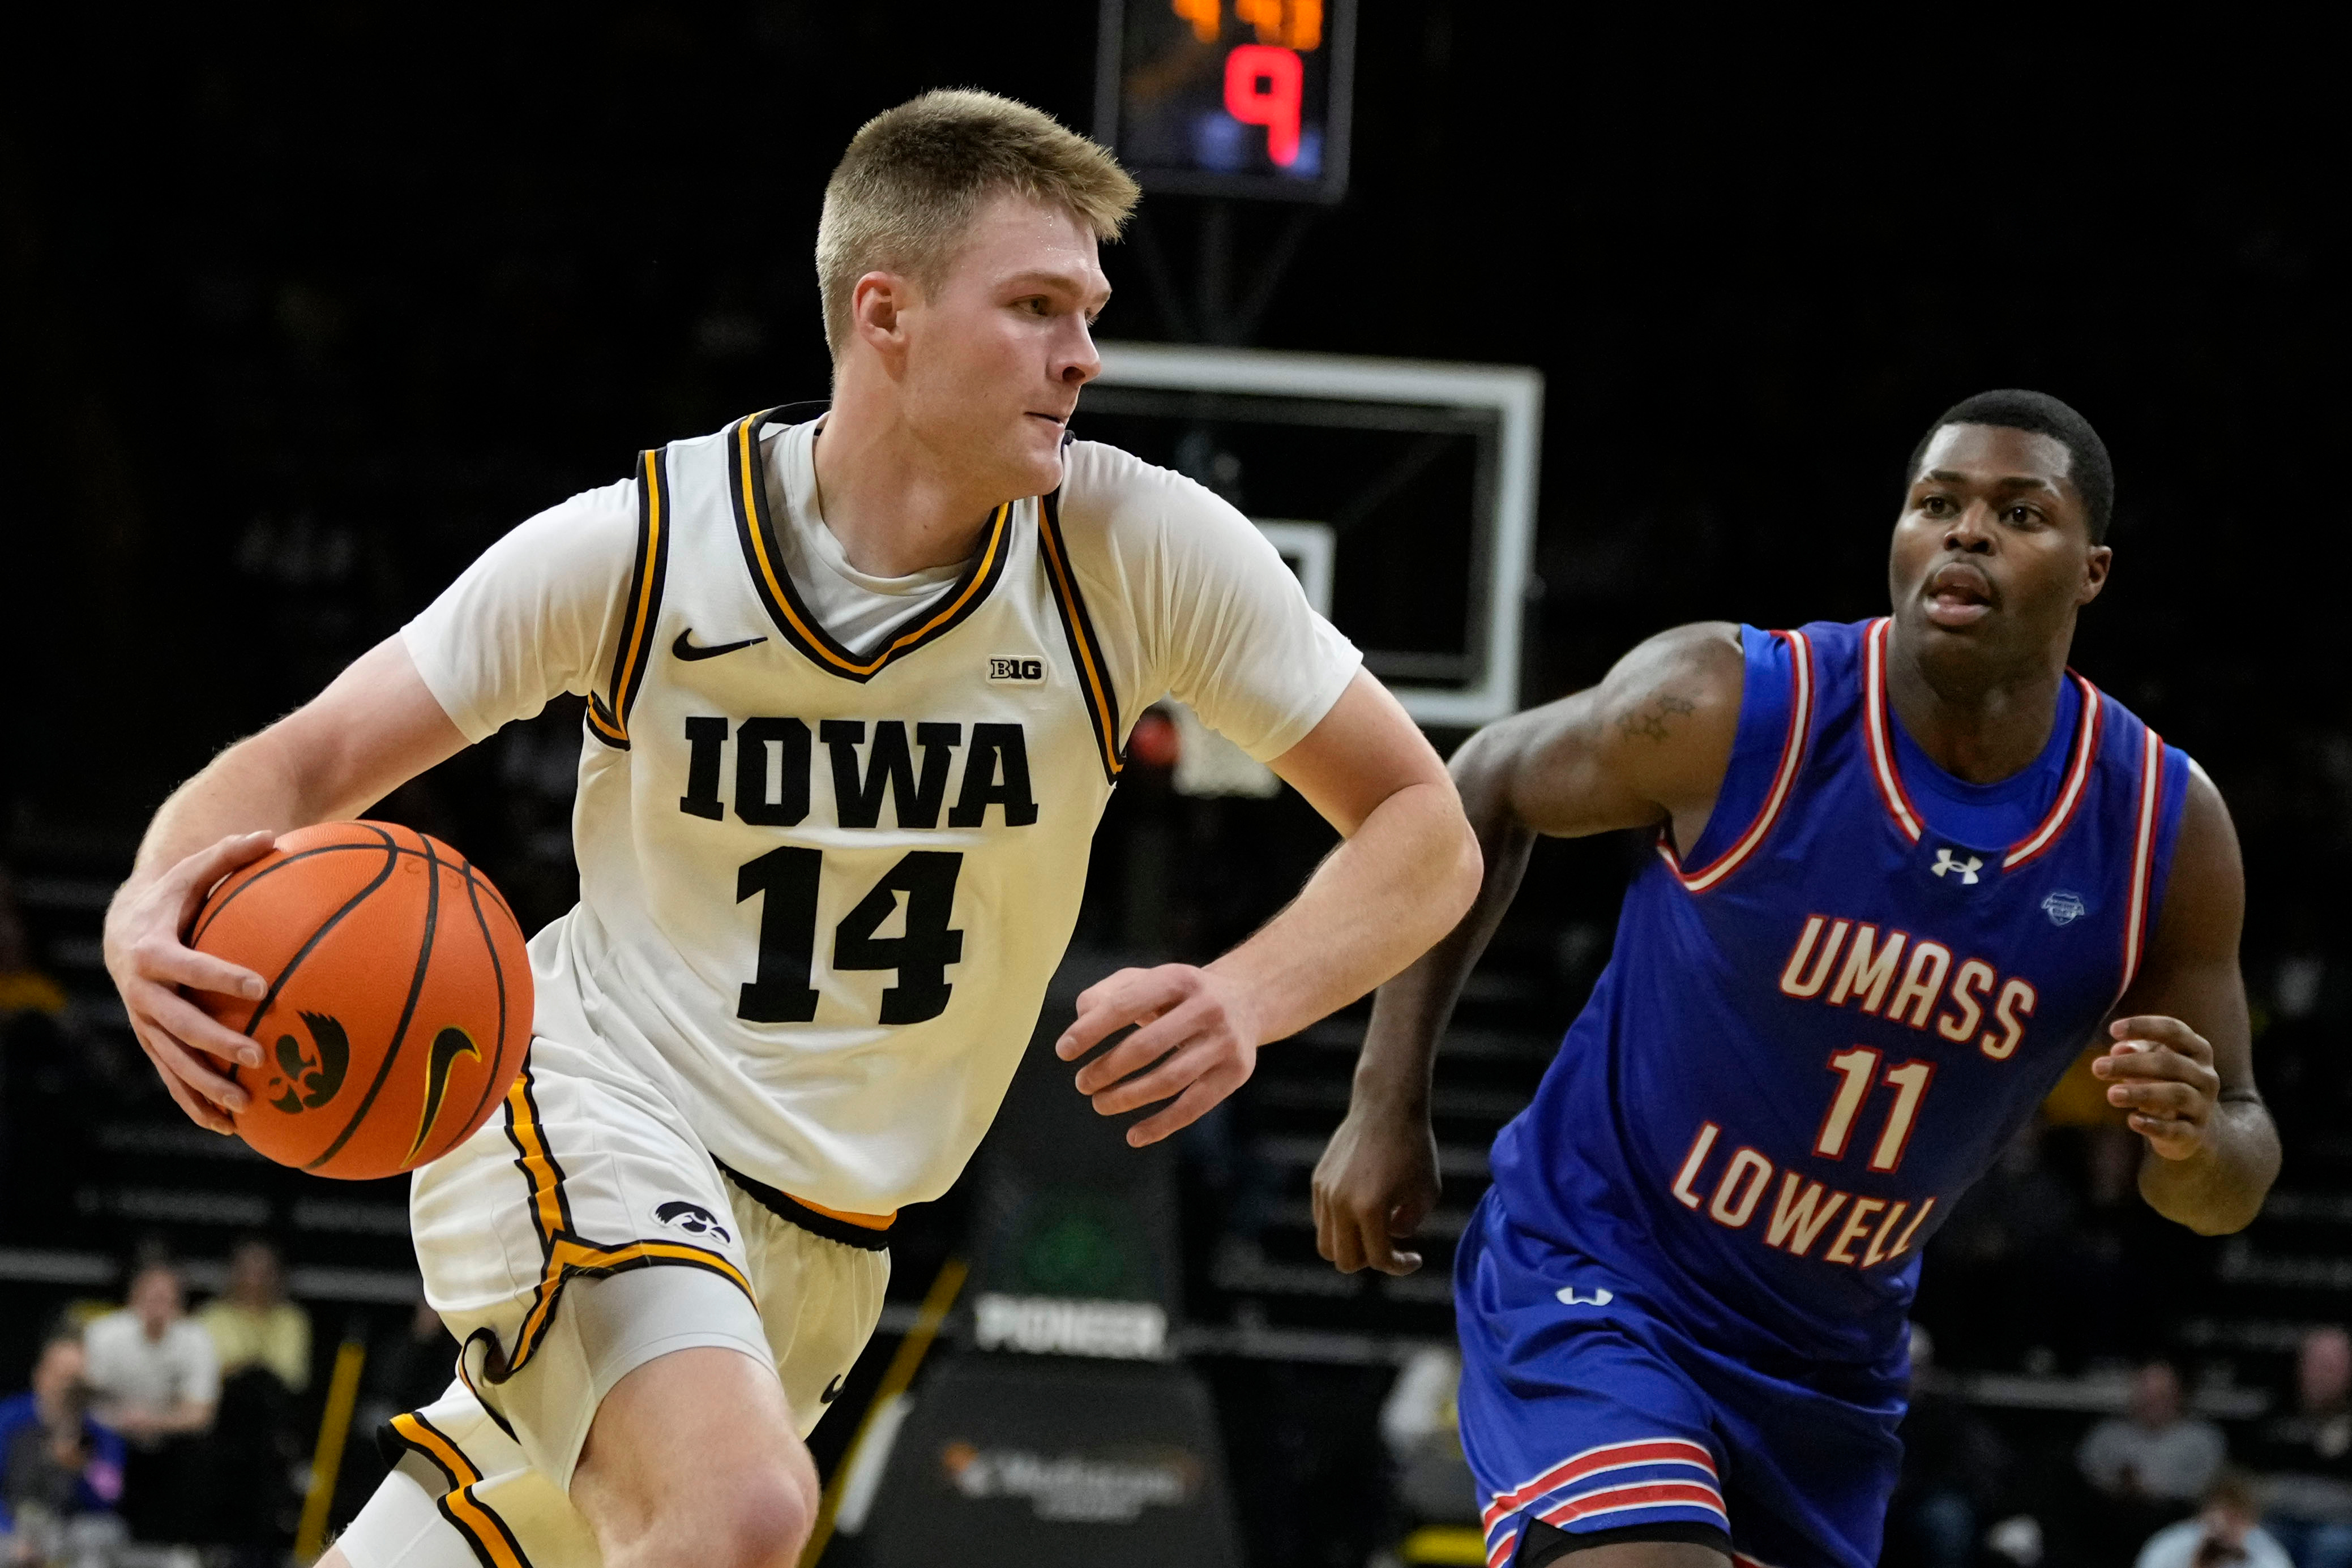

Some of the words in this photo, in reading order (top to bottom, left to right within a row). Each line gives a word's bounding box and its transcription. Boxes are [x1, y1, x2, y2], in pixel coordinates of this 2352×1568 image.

[1225, 44, 1303, 166] 9
[680, 717, 1038, 828] IOWA
[736, 846, 964, 1025] 14
[1779, 914, 2037, 1060] UMASS
[1812, 1044, 1936, 1174] 11
[1671, 1120, 1937, 1269] LOWELL
